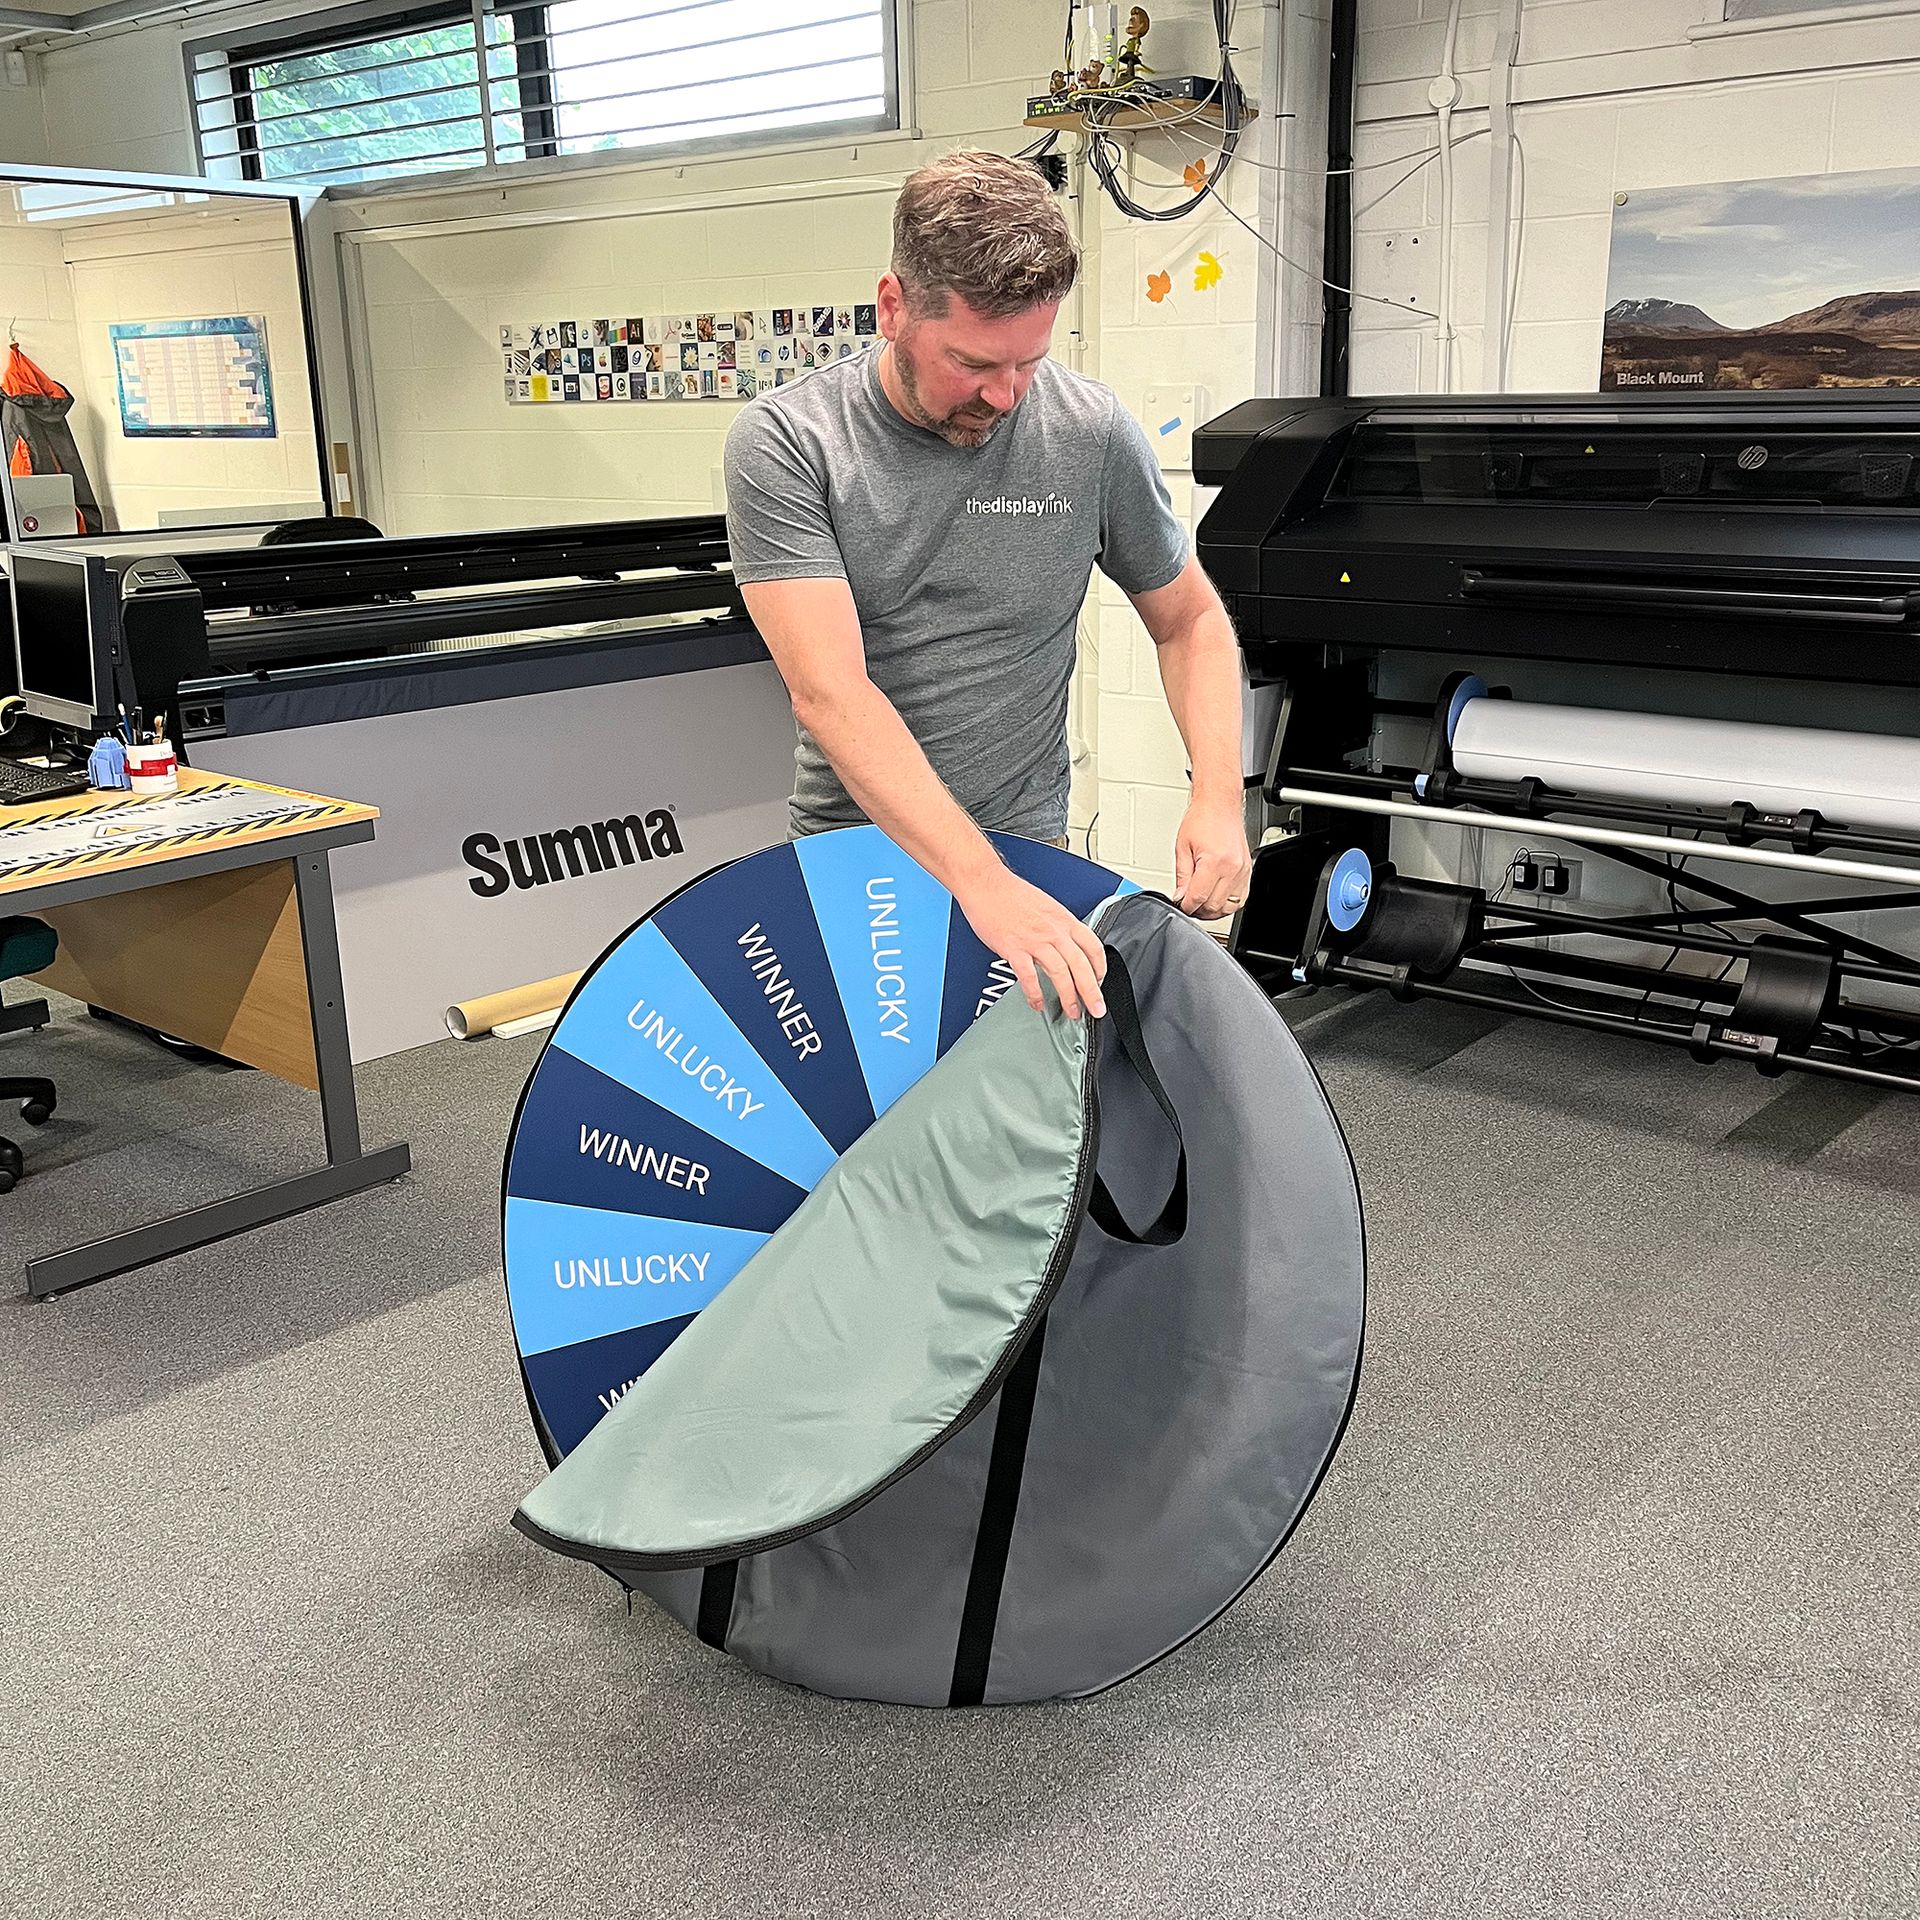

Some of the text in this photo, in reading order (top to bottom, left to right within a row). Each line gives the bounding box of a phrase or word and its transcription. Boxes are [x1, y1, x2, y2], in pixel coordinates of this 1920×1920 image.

[1616, 371, 1705, 386] Black Mount
[1737, 445, 1769, 470] hp
[965, 492, 1074, 517] thedisplaylink
[462, 808, 685, 898] Summa
[736, 922, 824, 1062] WINNER
[865, 877, 911, 1044] UNLUCKY
[627, 999, 766, 1121] UNLUCKY
[579, 1123, 711, 1196] WINNER
[554, 1252, 711, 1289] UNLUCKY
